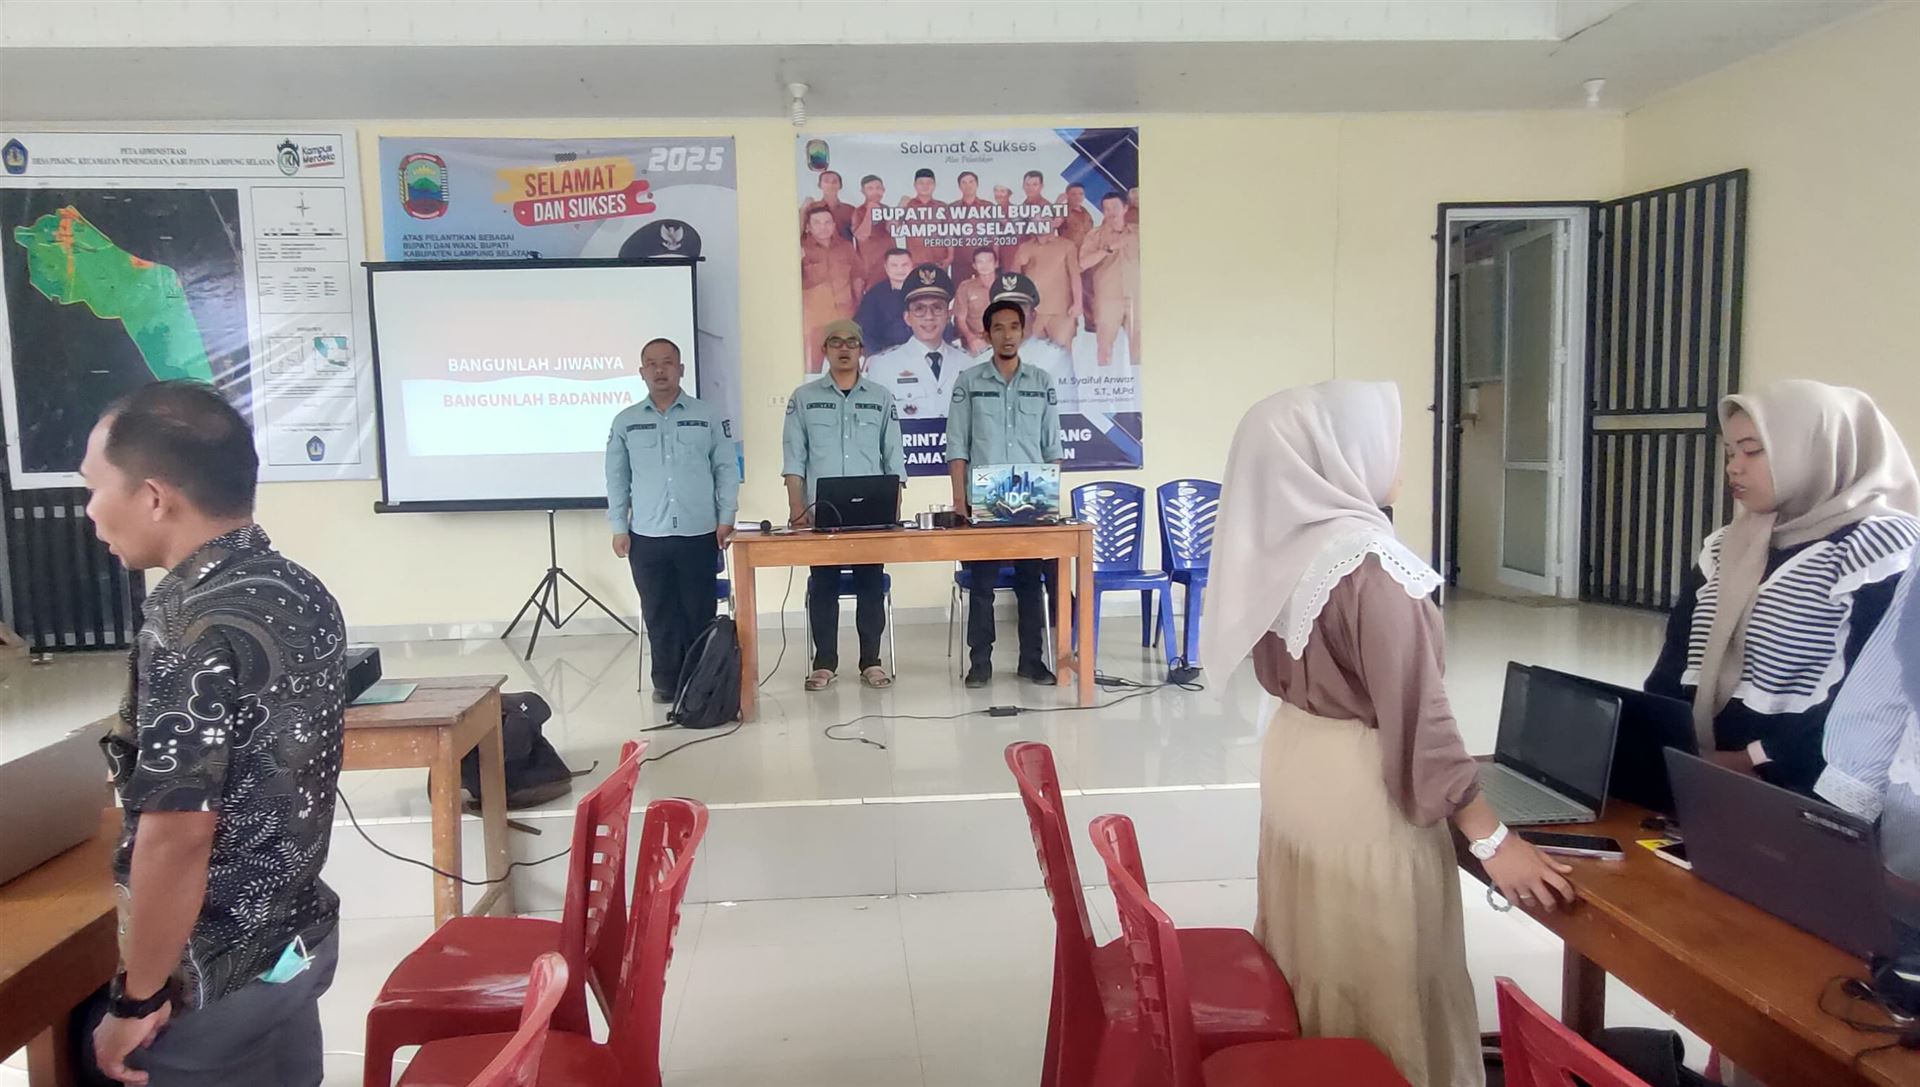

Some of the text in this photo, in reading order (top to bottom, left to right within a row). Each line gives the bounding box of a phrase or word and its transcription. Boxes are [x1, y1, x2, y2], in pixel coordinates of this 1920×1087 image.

[900, 140, 1036, 154] Selamat & Sukses
[648, 147, 725, 172] 2025
[524, 164, 616, 198] SELAMAT
[534, 193, 626, 222] DAN SUKSES
[872, 204, 1068, 221] BUPATI & WAKIL BUPATI
[890, 222, 1050, 237] LAMPUNG SELATAN
[924, 238, 964, 247] PERIODE
[448, 356, 624, 372] BANGUNLAH JIWANYA
[443, 392, 633, 408] BANGUNLAH BADANNYA
